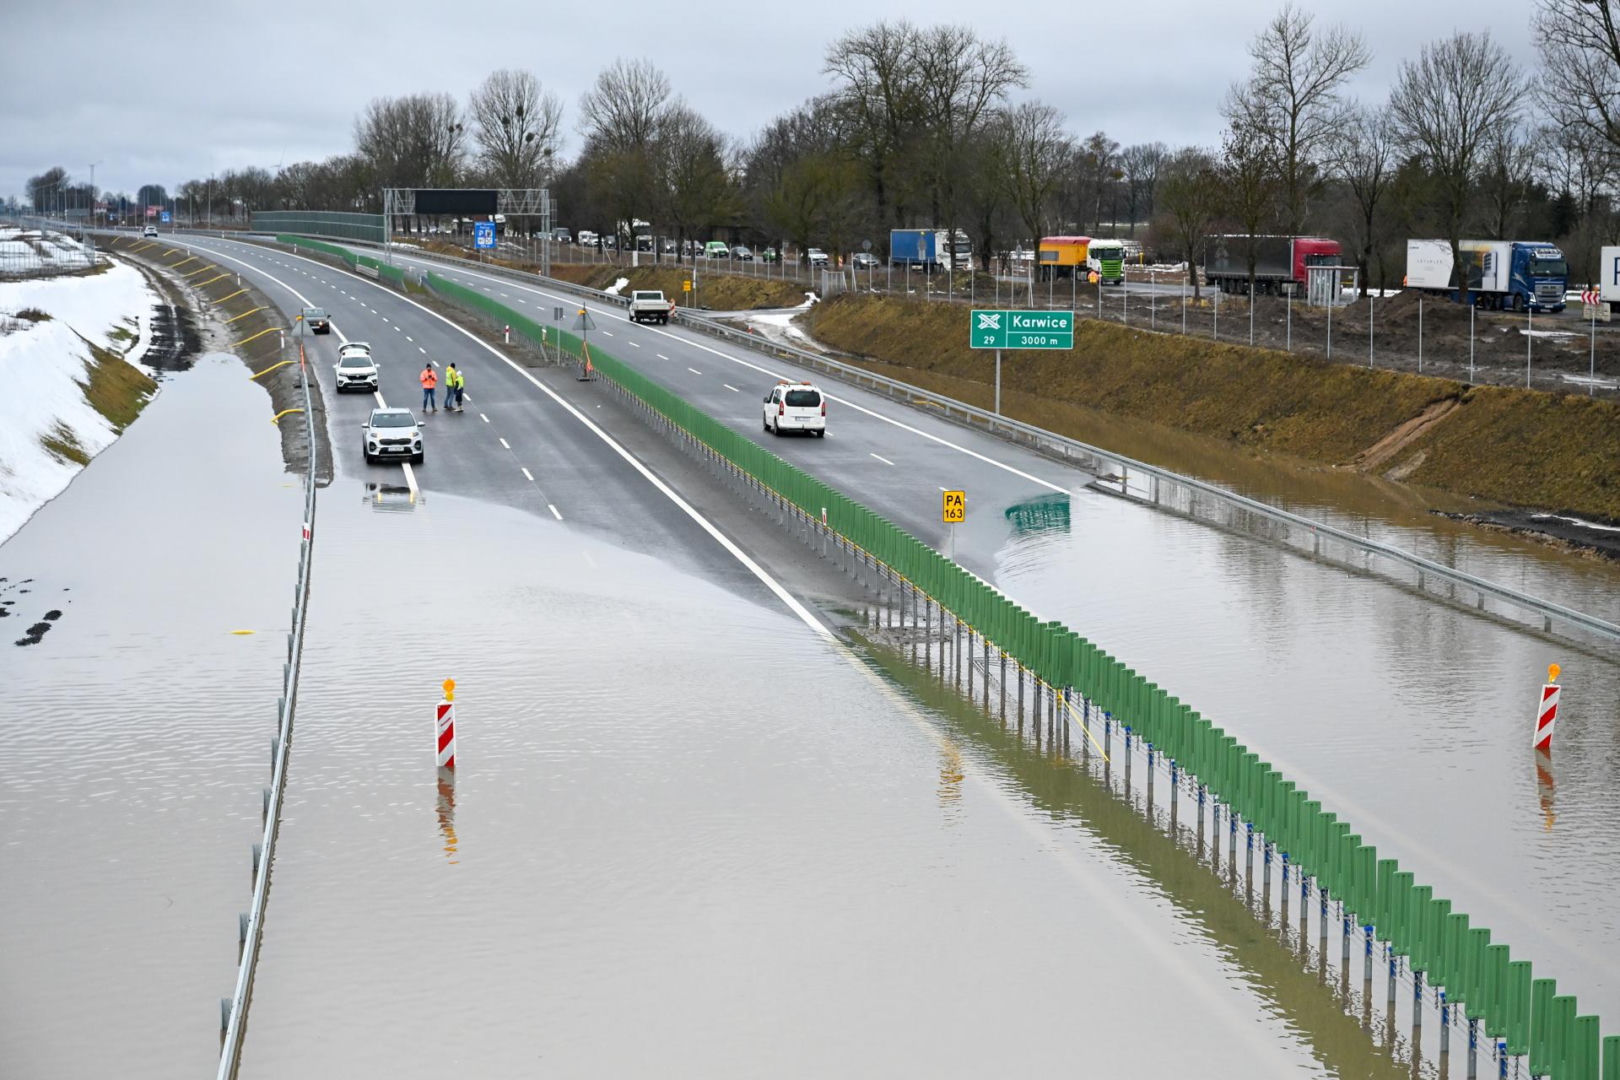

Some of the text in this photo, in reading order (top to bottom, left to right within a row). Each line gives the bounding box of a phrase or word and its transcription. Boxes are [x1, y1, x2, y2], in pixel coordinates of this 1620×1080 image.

[1013, 316, 1068, 328] Karwice
[984, 336, 995, 344] 29
[1022, 336, 1046, 344] 3000
[946, 495, 962, 506] PA
[946, 508, 962, 518] 163
